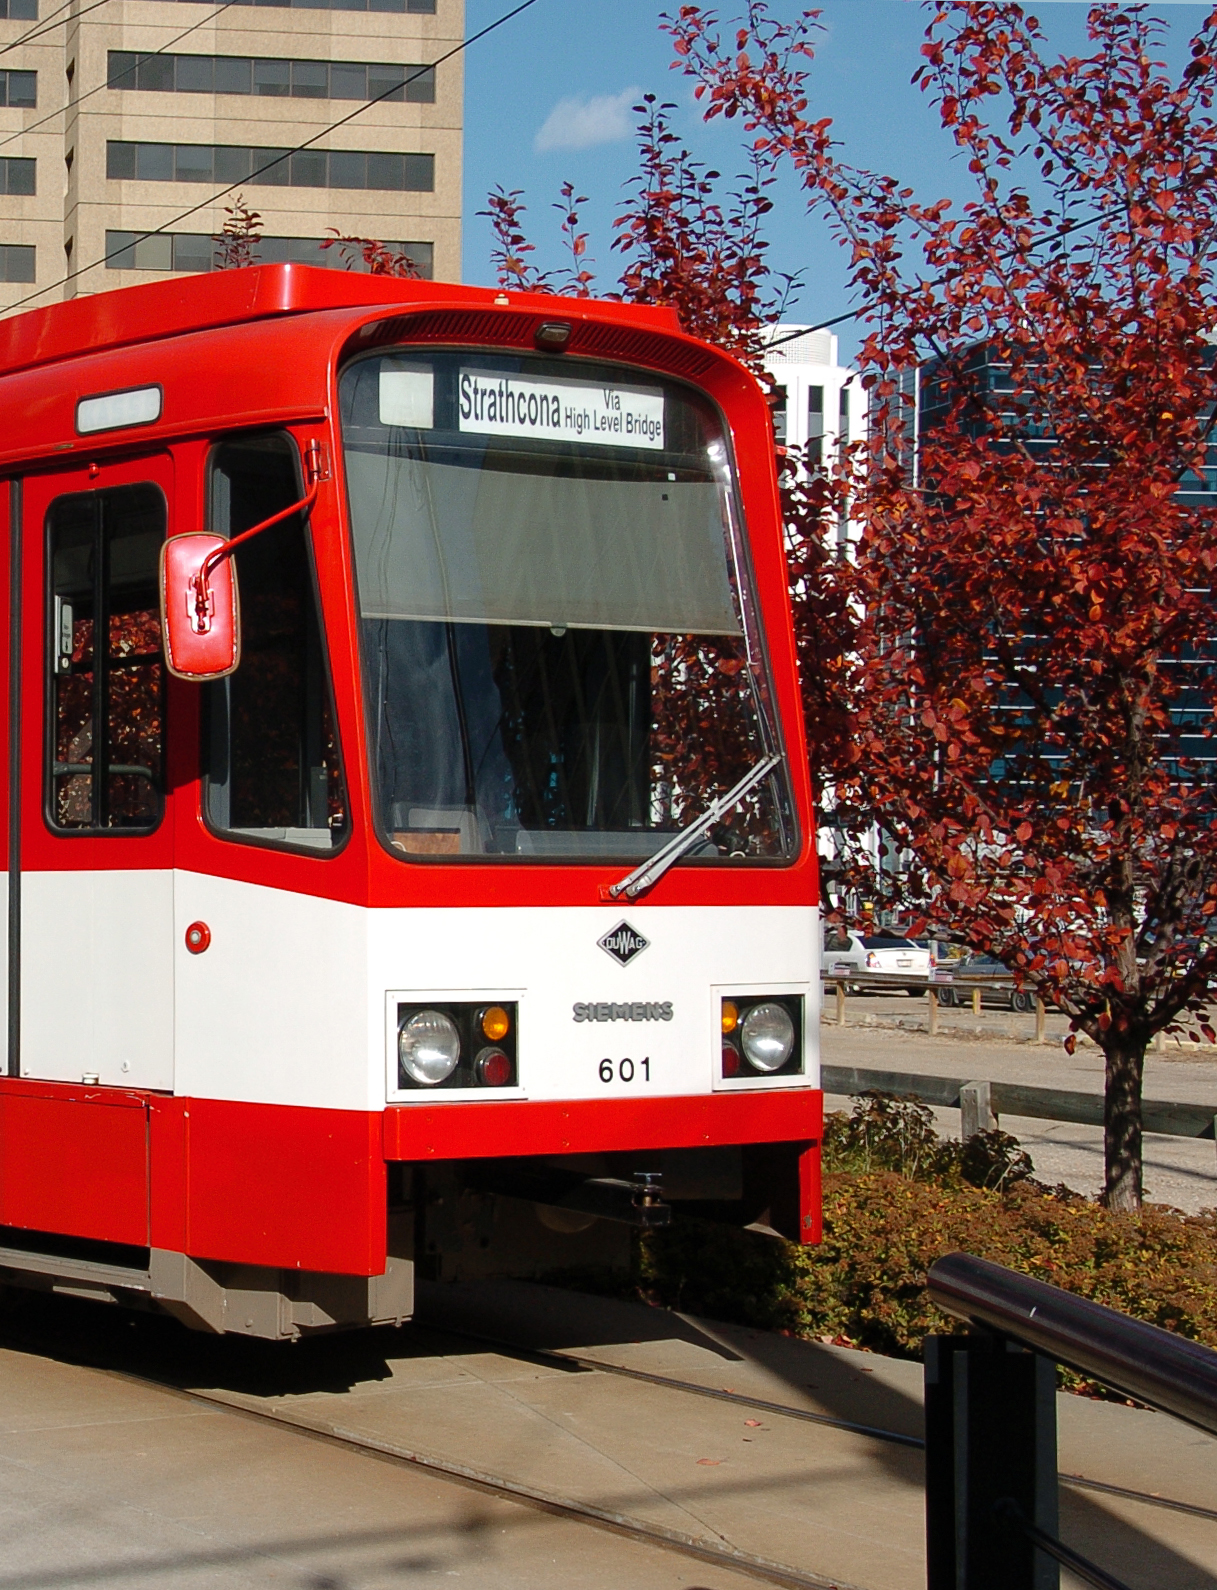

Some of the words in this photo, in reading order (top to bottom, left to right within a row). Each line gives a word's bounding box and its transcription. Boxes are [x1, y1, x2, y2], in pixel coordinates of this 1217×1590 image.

[459, 373, 561, 428] Strathcona
[603, 388, 621, 411] Via
[564, 406, 590, 435] High
[593, 409, 623, 433] Level
[626, 412, 661, 441] Bridge
[605, 931, 644, 955] DUWAG
[572, 1001, 674, 1023] SIEMENS
[598, 1056, 650, 1083] 601
